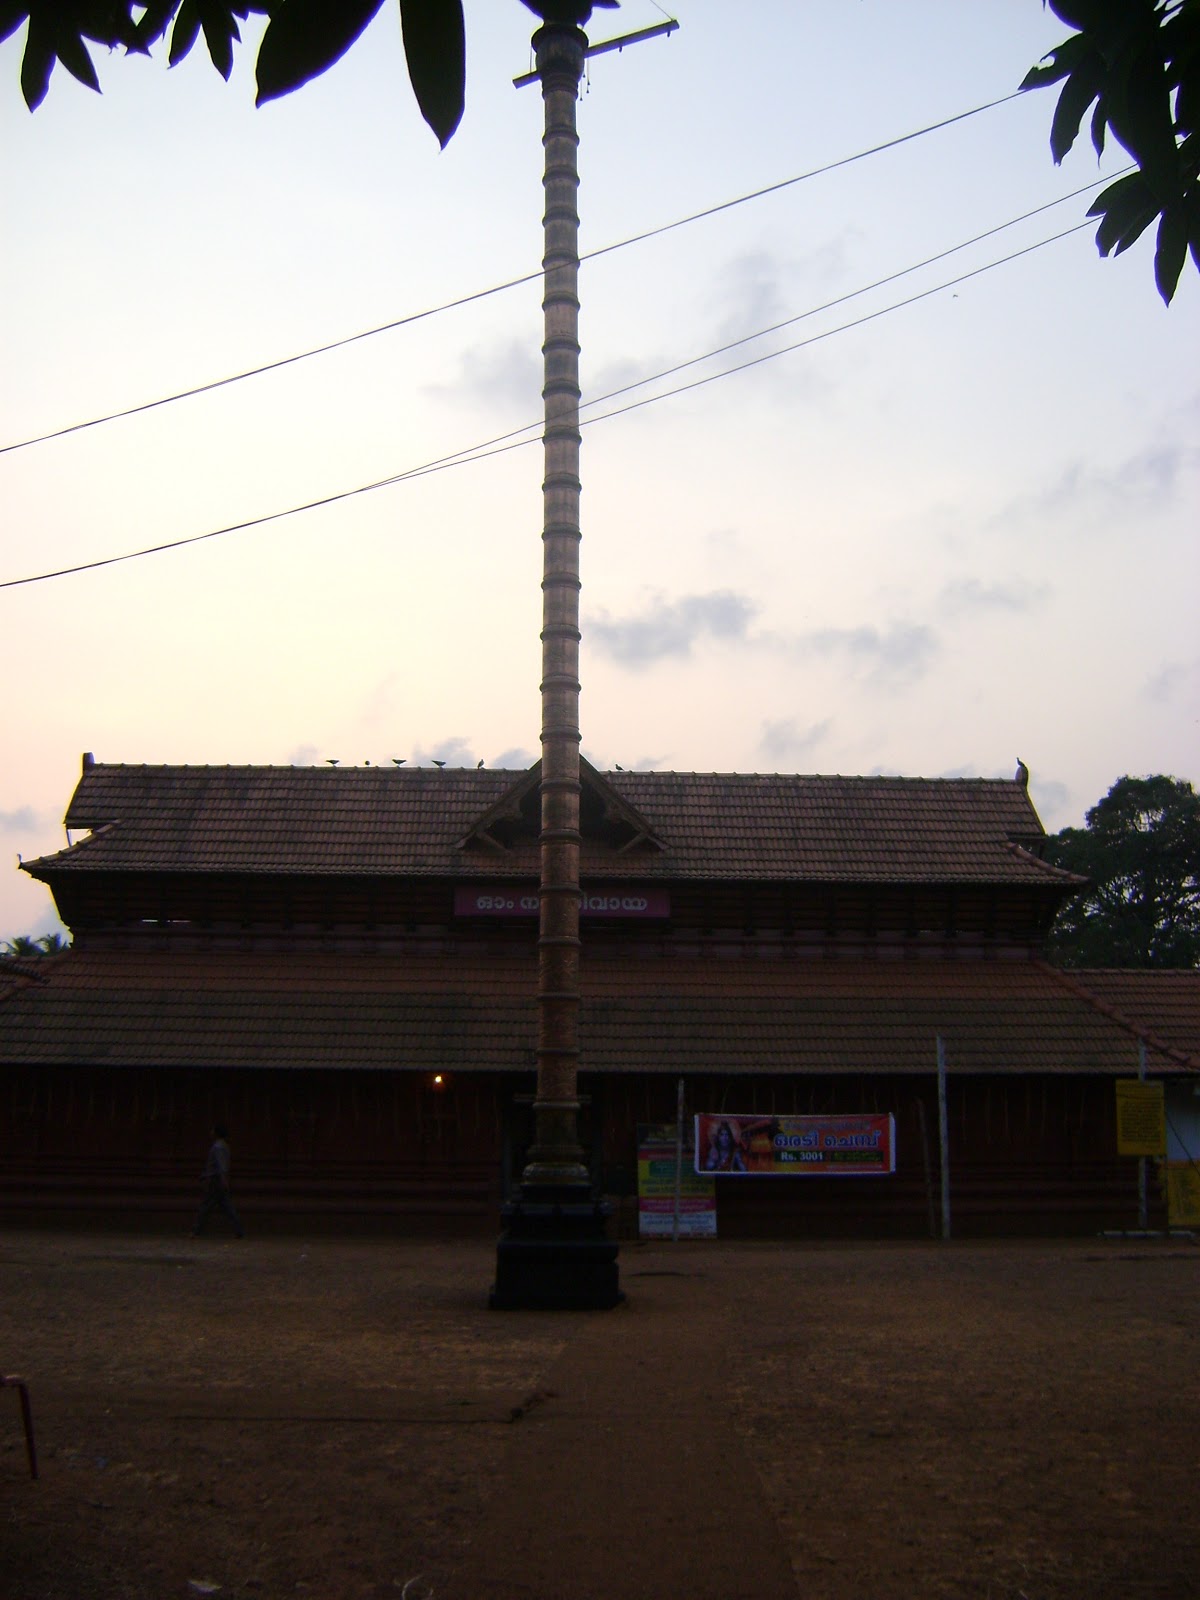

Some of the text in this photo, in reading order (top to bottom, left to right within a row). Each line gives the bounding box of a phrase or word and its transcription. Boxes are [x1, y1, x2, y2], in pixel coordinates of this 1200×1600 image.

[476, 896, 515, 910] ഓം
[780, 1151, 797, 1161] Rs.
[800, 1151, 823, 1161] 3001
